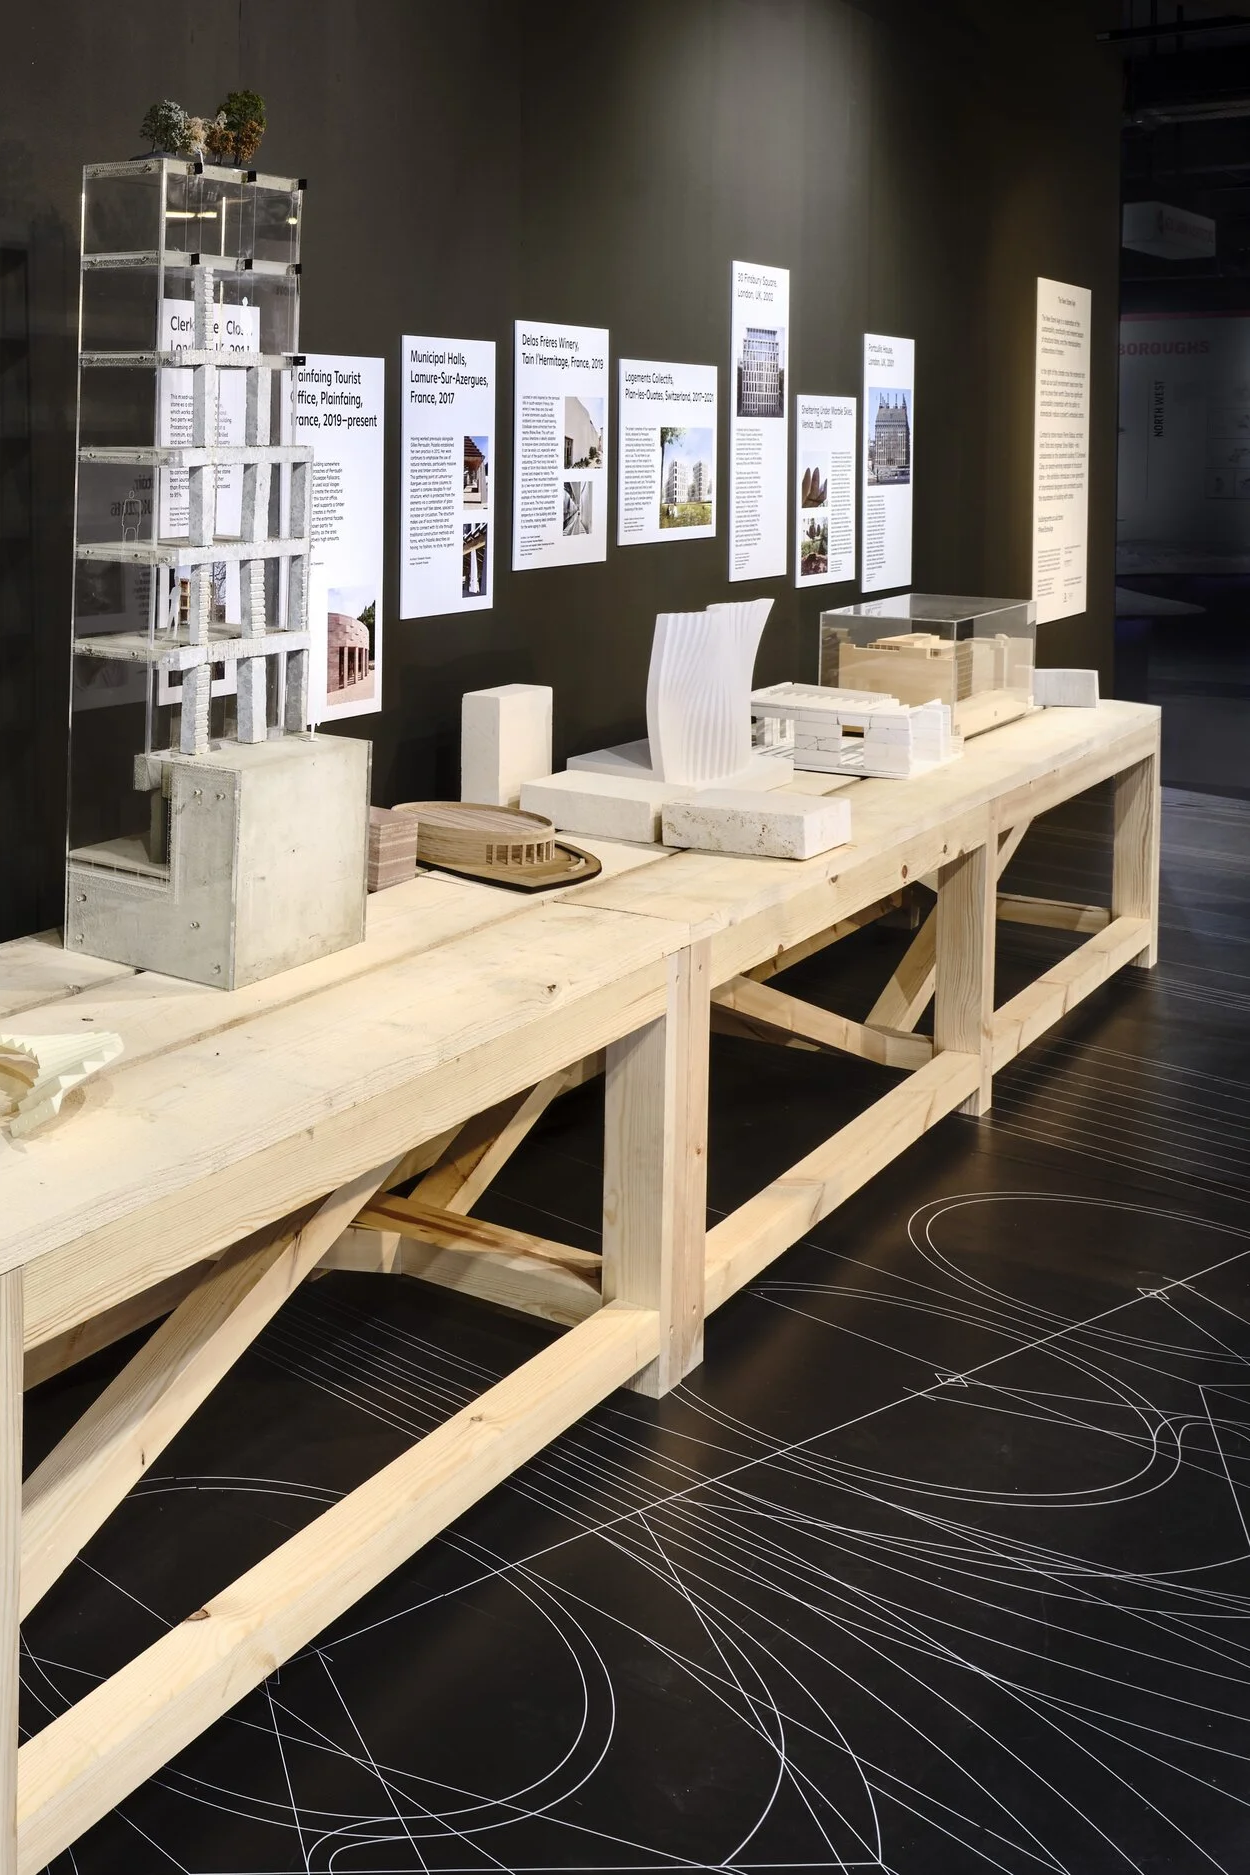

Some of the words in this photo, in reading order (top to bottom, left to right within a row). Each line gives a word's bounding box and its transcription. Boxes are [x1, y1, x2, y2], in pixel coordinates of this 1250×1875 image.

[521, 333, 538, 346] Delas
[539, 335, 557, 348] Frères
[558, 337, 579, 352] Winery,
[410, 349, 445, 366] Municipal
[447, 352, 466, 367] Halls,
[521, 352, 534, 364] Tain
[570, 355, 590, 369] France,
[591, 358, 603, 369] 2019
[291, 368, 332, 386] ainfaing
[333, 370, 361, 384] Tourist
[410, 370, 488, 388] Lamure-Sur-Azergues,
[320, 390, 363, 409] Plainfaing,
[410, 390, 437, 405] France,
[438, 391, 454, 404] 2017
[1154, 380, 1165, 406] WEST
[322, 413, 377, 429] 2019–present
[1154, 407, 1164, 437] NORTH
